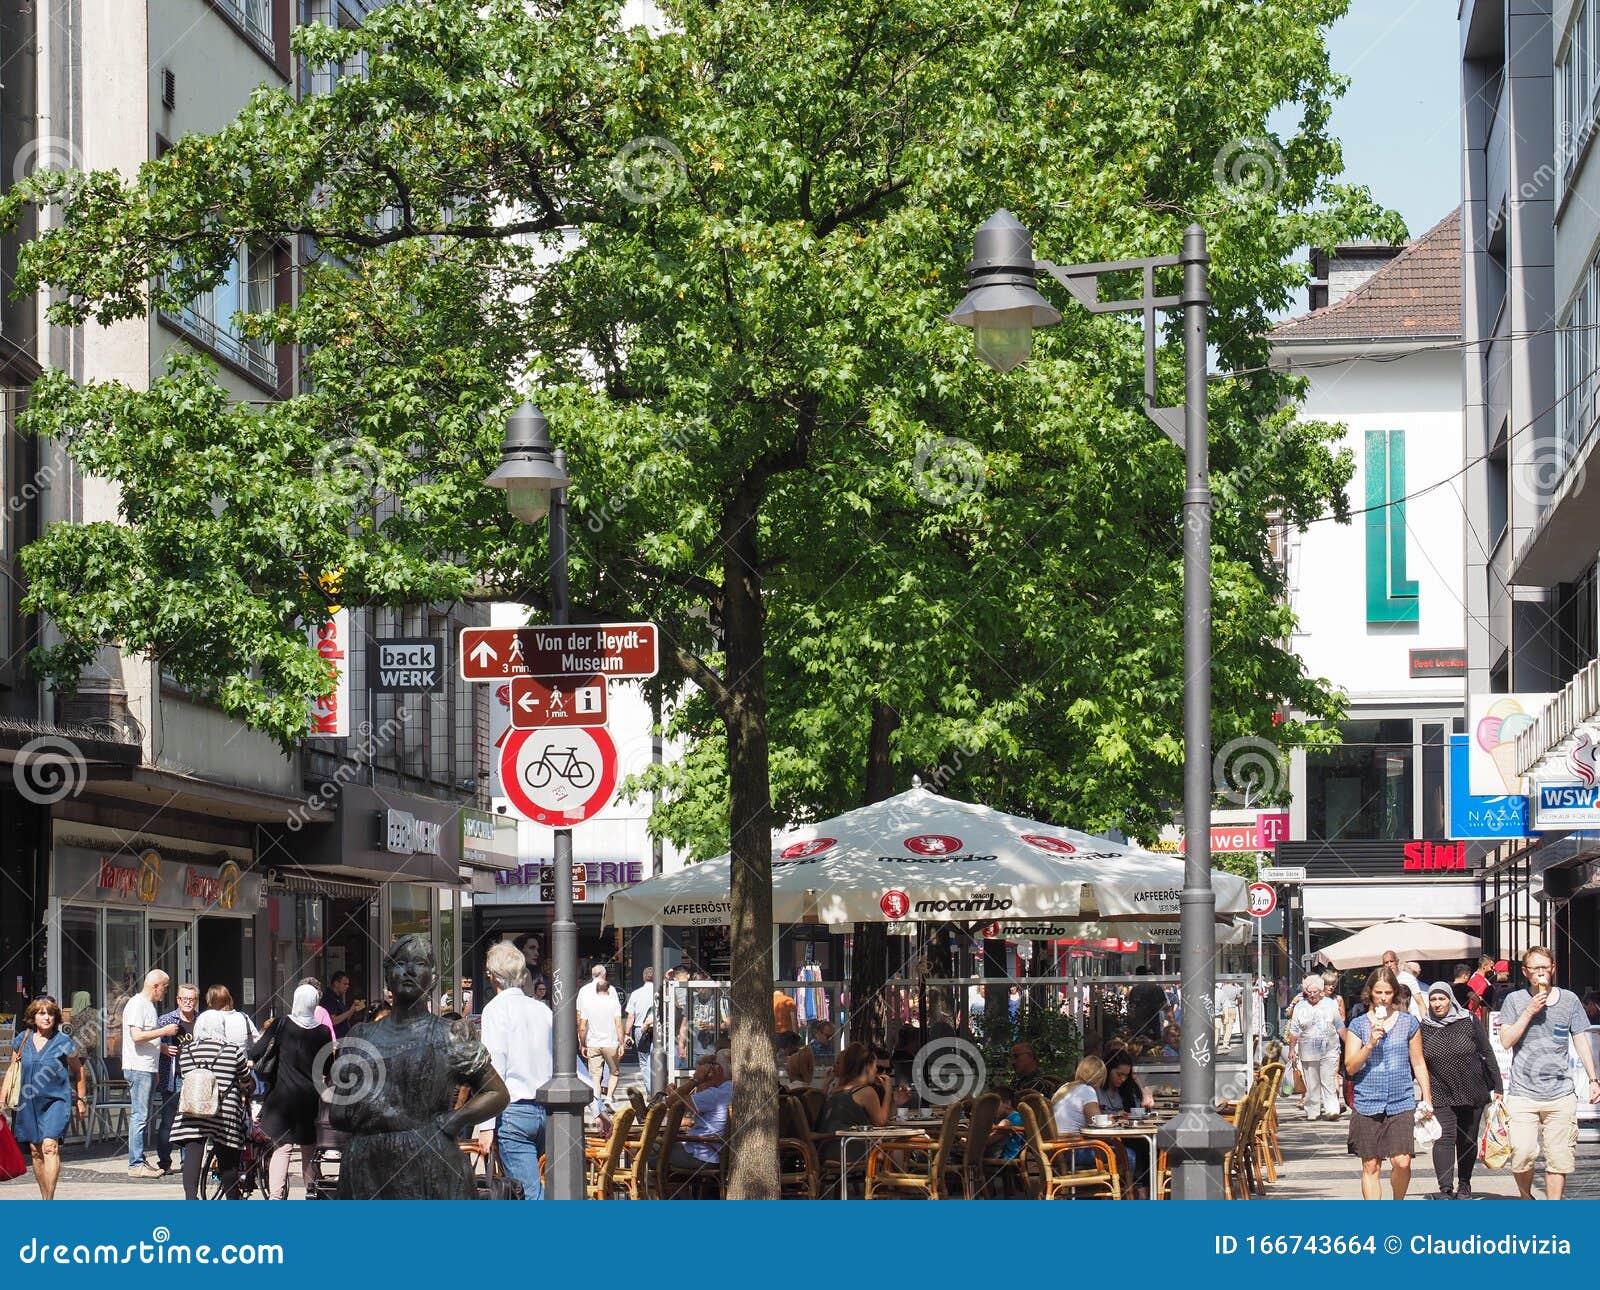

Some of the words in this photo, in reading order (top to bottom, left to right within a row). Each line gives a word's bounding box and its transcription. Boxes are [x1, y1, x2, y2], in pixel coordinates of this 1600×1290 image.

[535, 633, 562, 651] Von
[567, 632, 592, 650] der
[597, 630, 648, 654] Heydt-
[382, 647, 433, 666] back
[561, 654, 624, 672] Museum
[502, 663, 509, 673] 3
[511, 662, 532, 673] min.
[380, 670, 435, 687] WERK
[551, 708, 569, 718] min.
[663, 901, 732, 915] KAFFEERÖSTE
[914, 893, 1013, 913] mocambo
